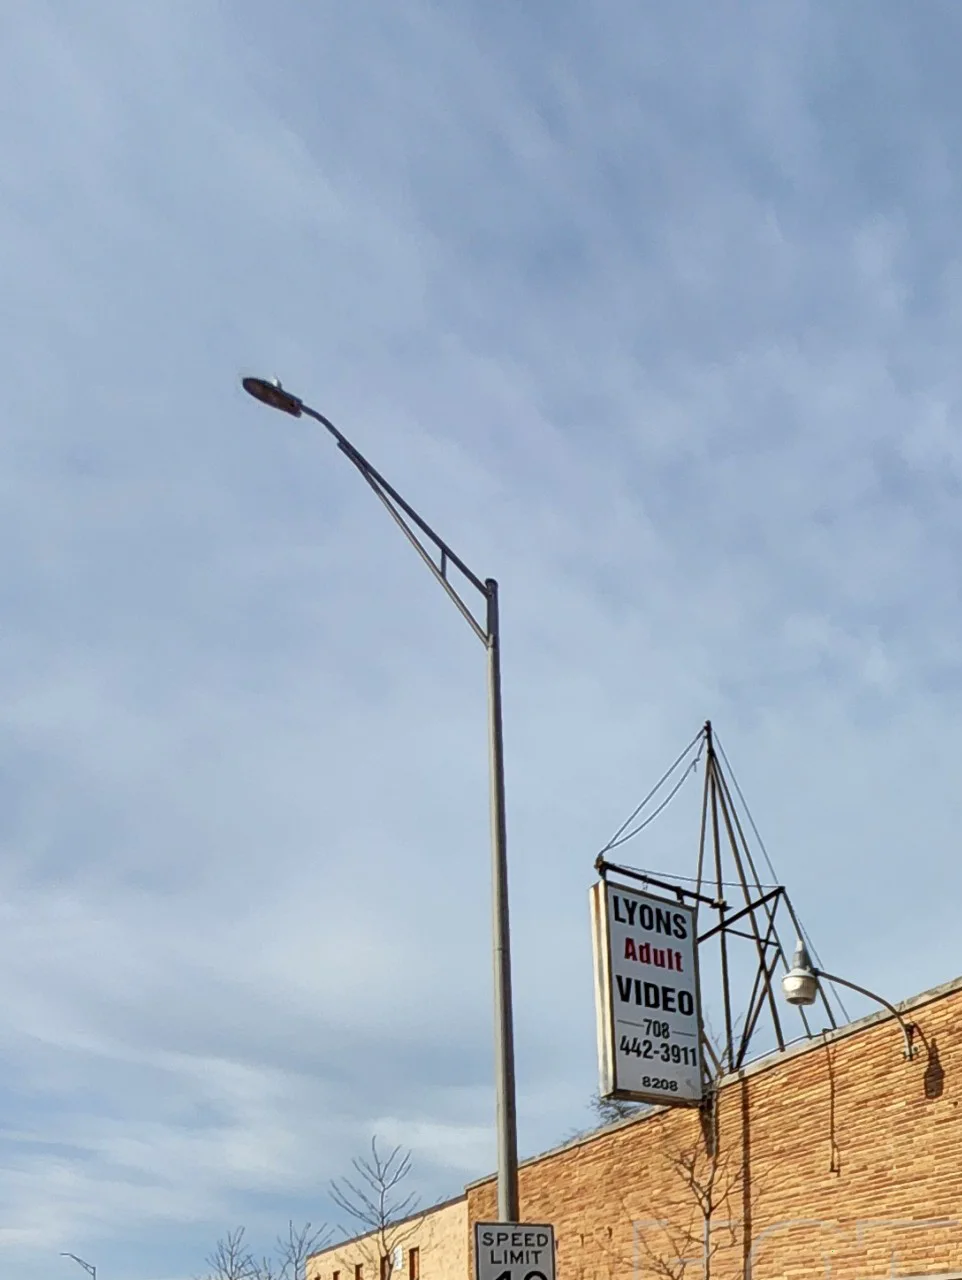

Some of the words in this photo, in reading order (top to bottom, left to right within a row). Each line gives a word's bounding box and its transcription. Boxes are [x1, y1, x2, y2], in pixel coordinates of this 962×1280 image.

[613, 895, 687, 940] LYONS
[624, 937, 683, 972] Adult
[616, 975, 694, 1016] VIDEO
[643, 1019, 670, 1039] 708
[620, 1035, 697, 1066] 442-3911
[642, 1076, 678, 1092] 8208
[482, 1232, 548, 1247] SPEED
[490, 1250, 542, 1265] LIMIT
